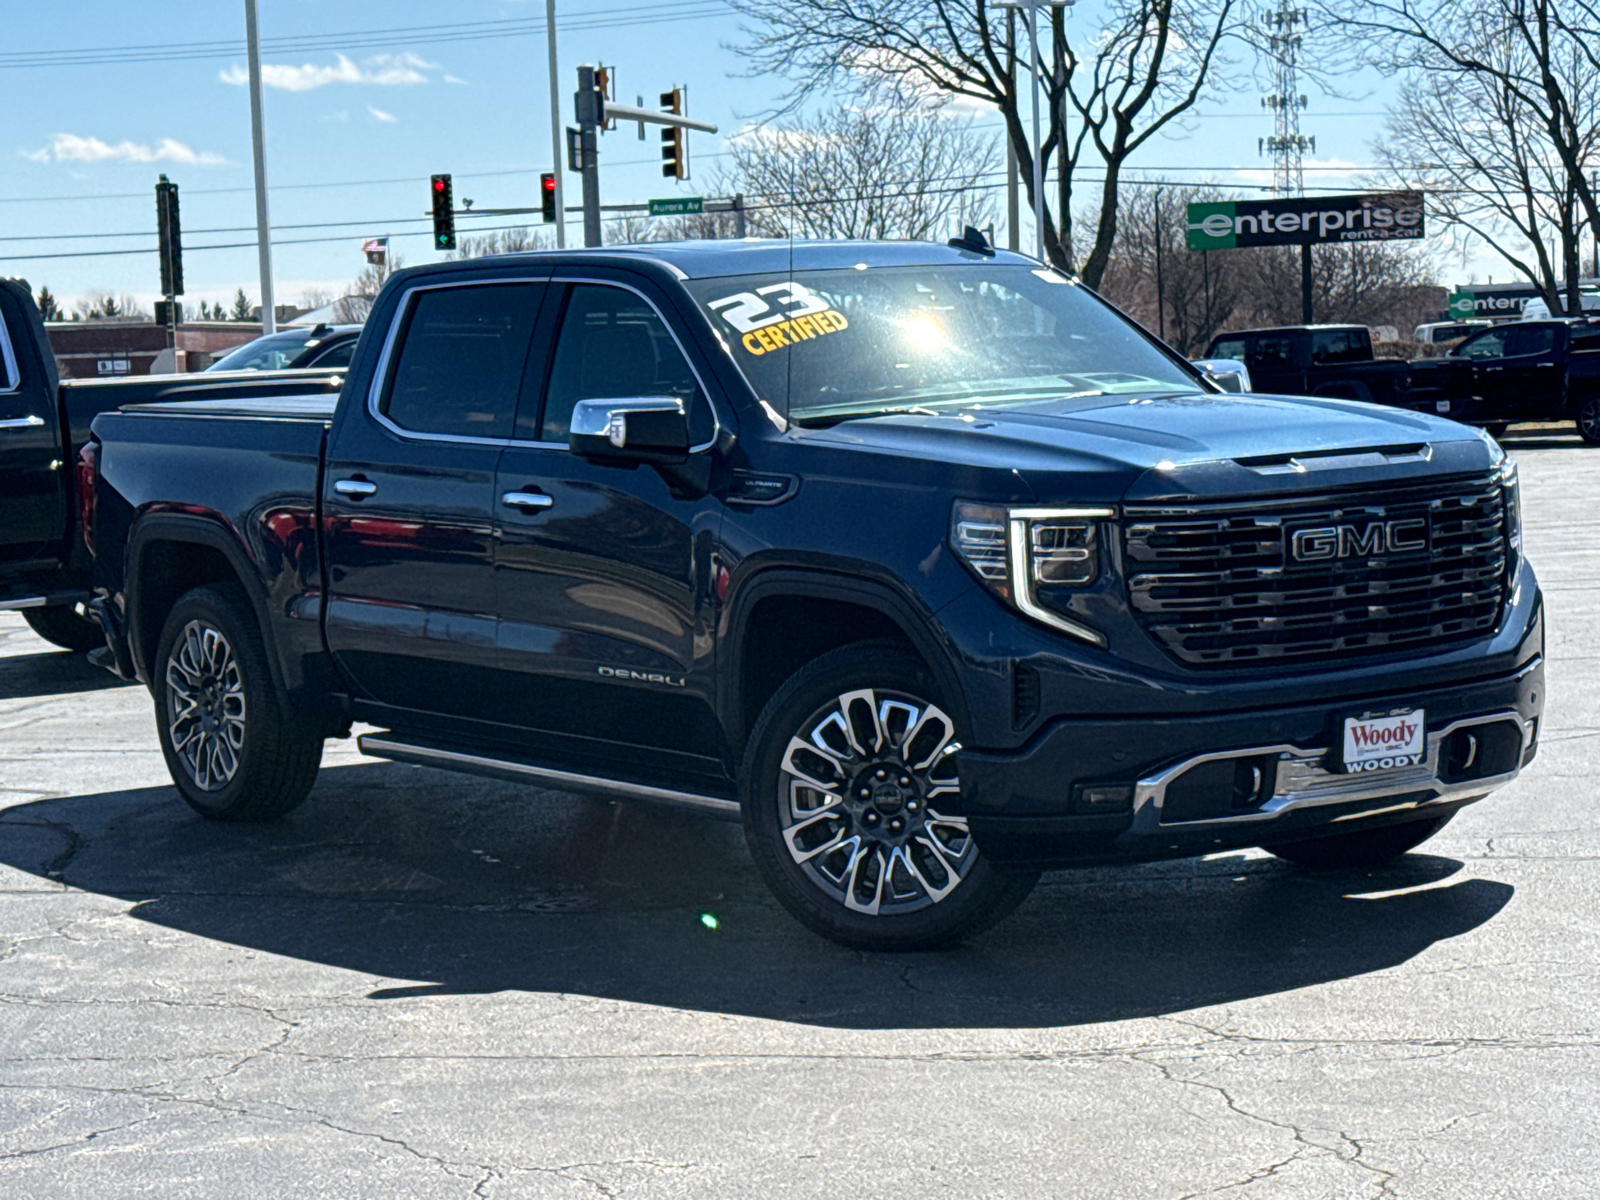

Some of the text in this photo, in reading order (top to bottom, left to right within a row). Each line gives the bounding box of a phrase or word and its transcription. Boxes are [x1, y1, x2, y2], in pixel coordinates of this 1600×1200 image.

[652, 202, 699, 212] Aurora Av
[1202, 202, 1421, 237] enterprise
[707, 281, 830, 334] 23
[741, 310, 849, 356] CERTIFIED
[1292, 518, 1425, 562] GMC
[598, 666, 685, 687] DENALI
[1350, 720, 1418, 747] Woody
[1346, 754, 1422, 773] WOODY
